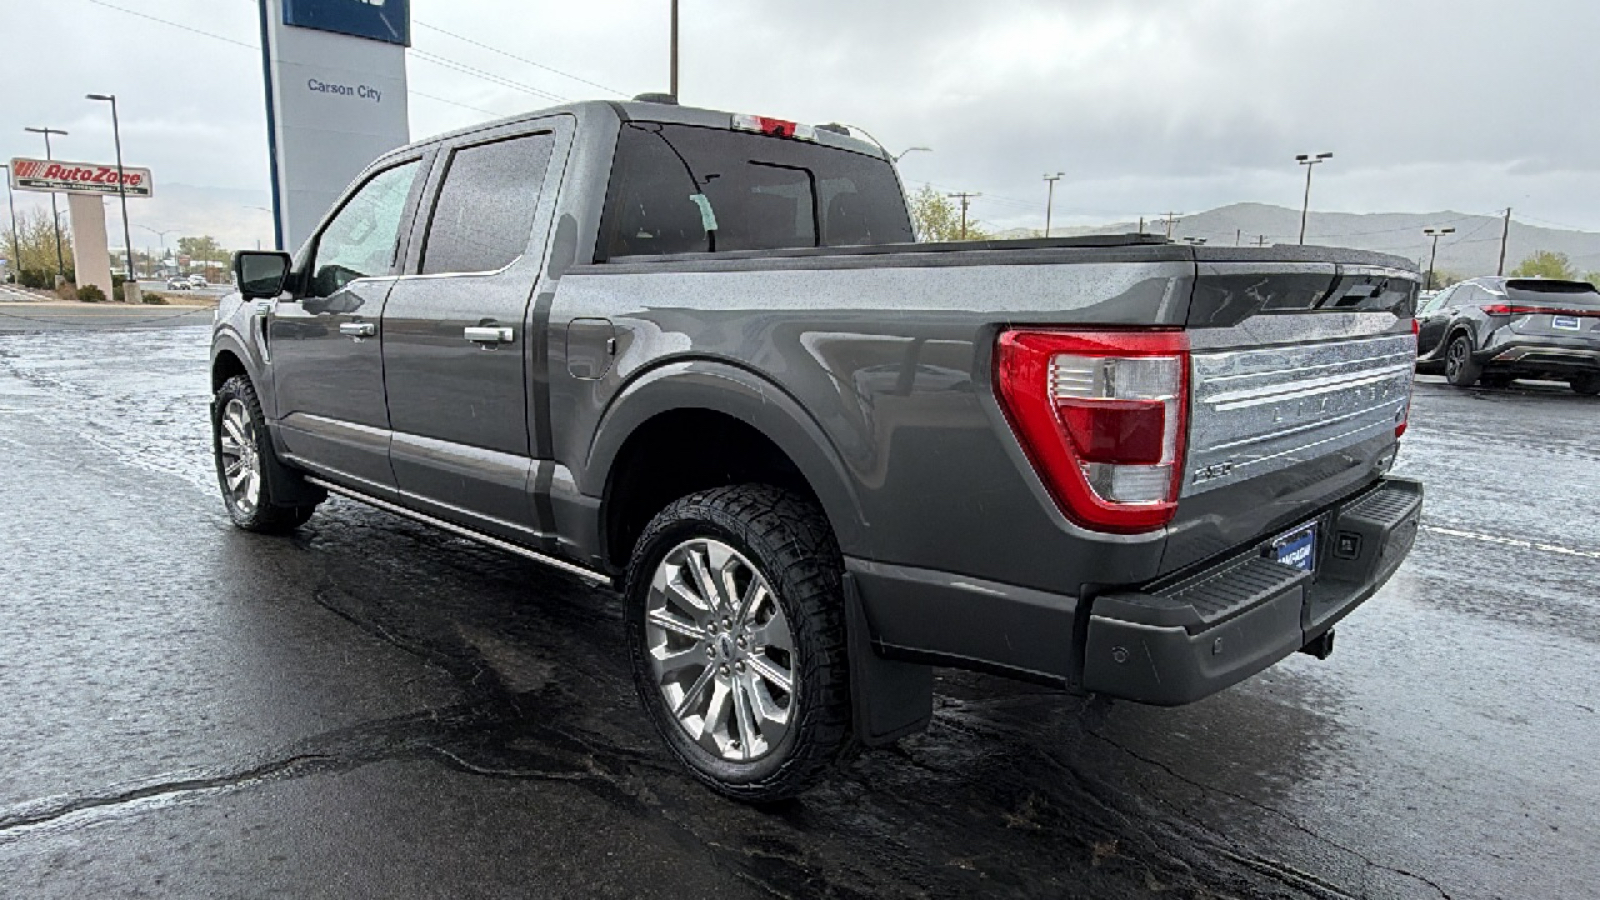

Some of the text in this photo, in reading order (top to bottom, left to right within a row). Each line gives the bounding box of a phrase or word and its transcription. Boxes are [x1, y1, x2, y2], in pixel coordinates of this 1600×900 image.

[308, 79, 382, 103] Carson City
[43, 164, 141, 185] AutoZone
